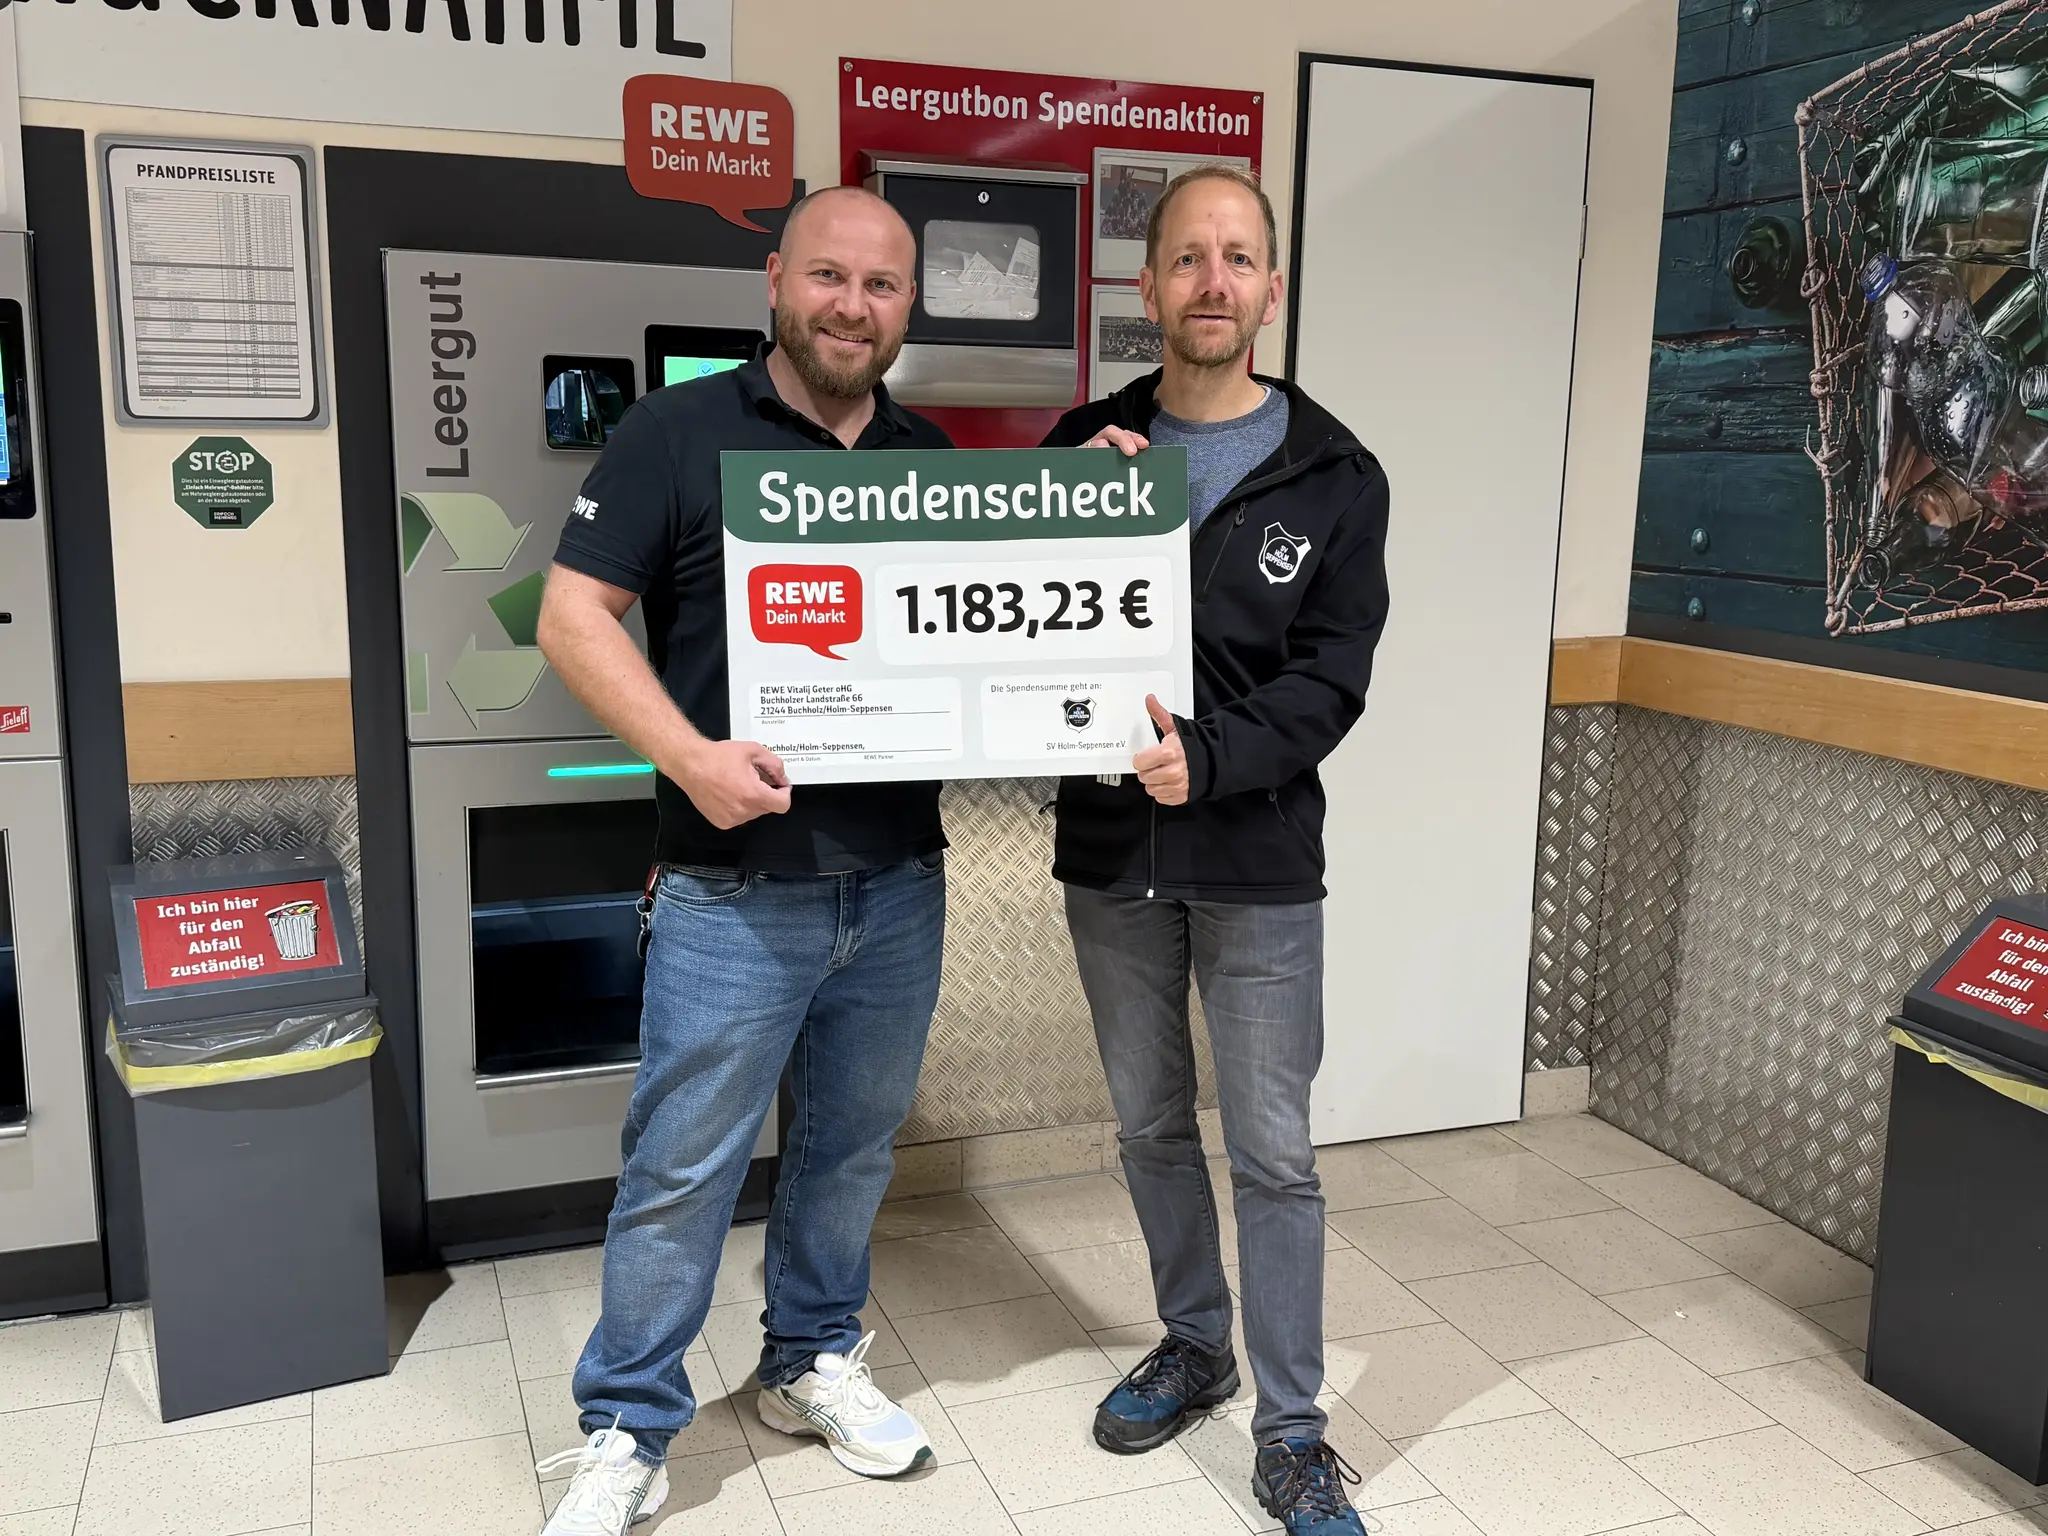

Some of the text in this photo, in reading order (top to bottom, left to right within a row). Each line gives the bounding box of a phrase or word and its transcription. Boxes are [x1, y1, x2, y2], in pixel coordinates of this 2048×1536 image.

[855, 76, 1250, 137] Leergutbon Spendenaktion
[650, 102, 771, 146] REWE
[650, 146, 772, 178] Dein Markt
[136, 163, 276, 184] PFANDPREISLISTE
[420, 271, 477, 478] Leergut
[188, 450, 255, 474] STOP
[758, 467, 1156, 536] Spendenscheck
[765, 580, 846, 605] REWE
[766, 607, 847, 626] Dein Markt
[896, 579, 1154, 639] 1.183,23 €
[760, 684, 852, 696] REWE Vitalij Geter oHG
[991, 684, 1004, 693] Die
[1006, 683, 1068, 694] Spendensumme
[1070, 683, 1088, 692] geht
[760, 694, 864, 706] Buchholzer Landstraße 66
[760, 704, 893, 715] 21244 Buchholz/Holm-Seppensen
[1046, 740, 1127, 750] SV Holm-Seppensen e.V.
[157, 896, 260, 918] Ich bin hier
[179, 918, 244, 936] für den
[1998, 928, 2025, 946] Ich
[188, 936, 242, 955] Abfall
[170, 953, 265, 978] zuständig!
[1998, 949, 2023, 967] für
[1986, 968, 2035, 992] Abfall
[1955, 982, 2035, 1015] zuständig!
